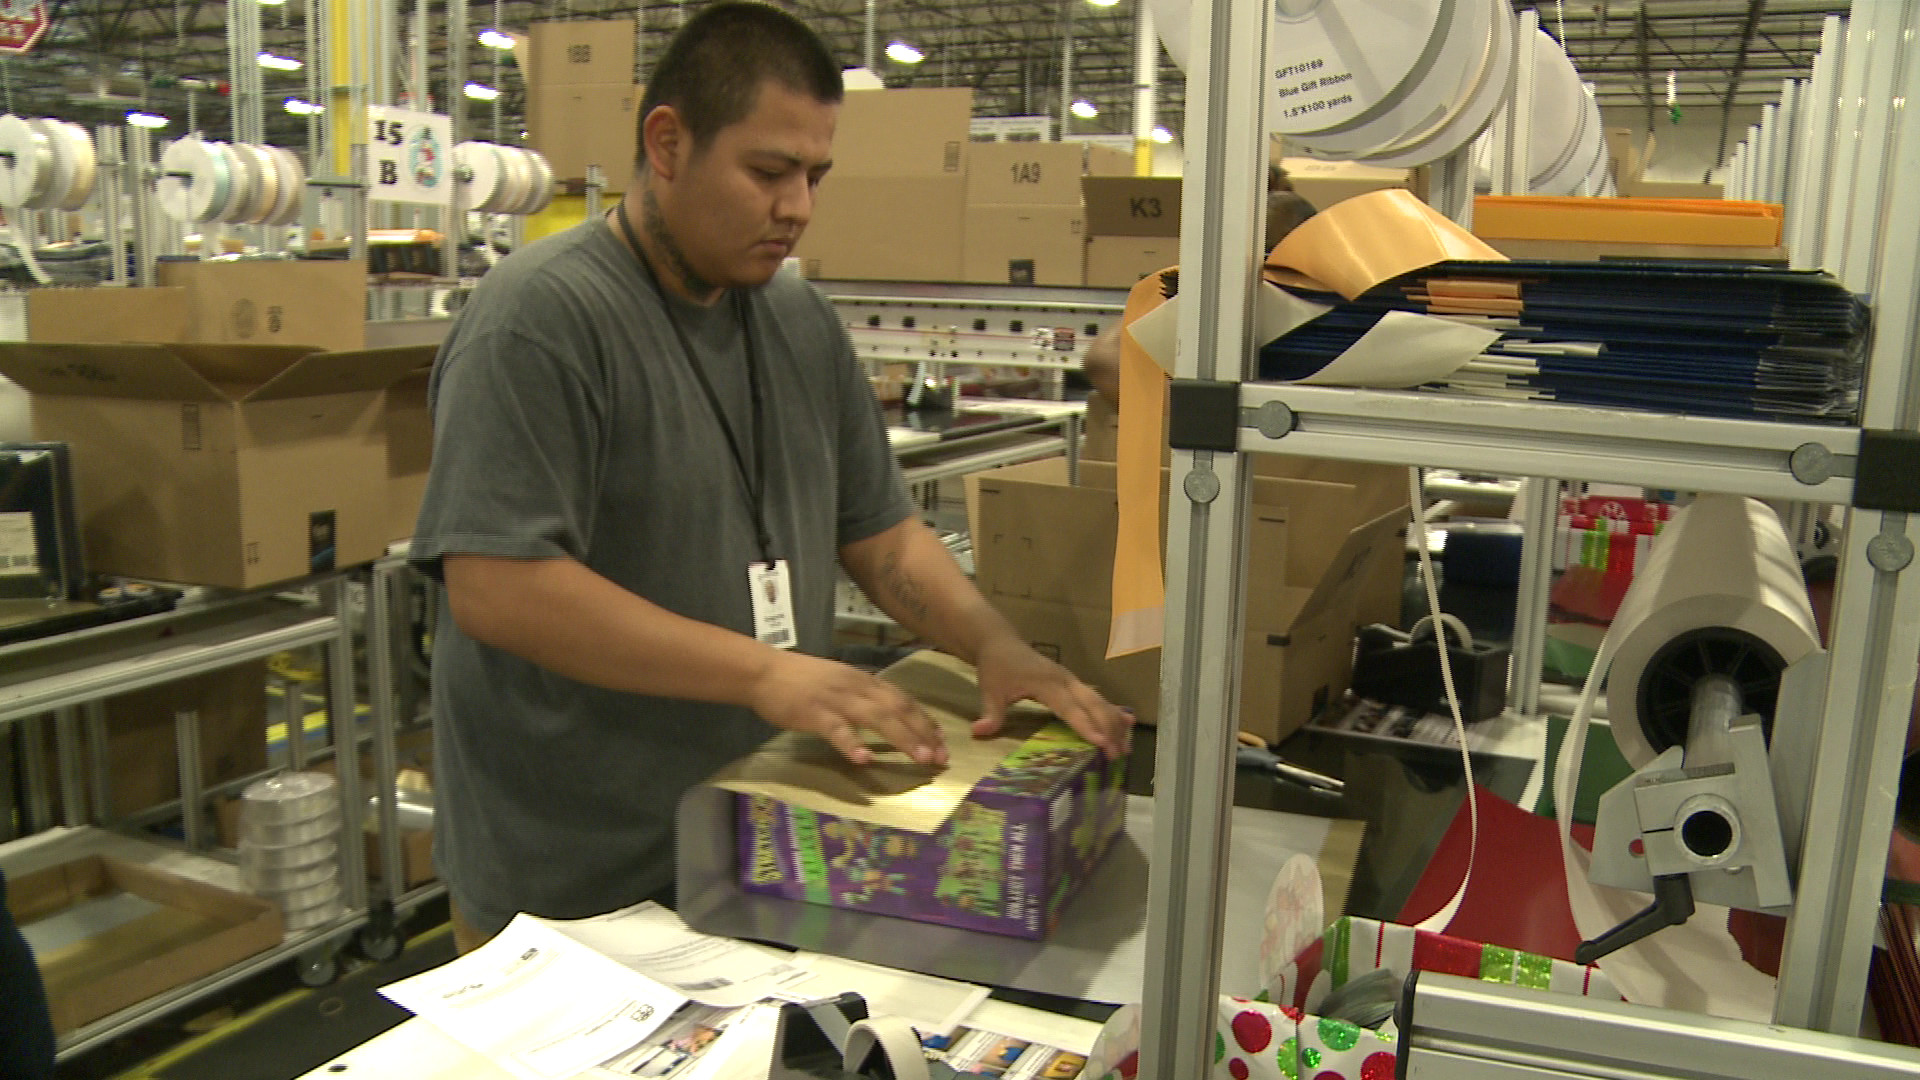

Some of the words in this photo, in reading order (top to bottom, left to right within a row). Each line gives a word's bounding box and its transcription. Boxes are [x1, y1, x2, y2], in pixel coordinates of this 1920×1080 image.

[1275, 58, 1323, 79] GFT10169
[1279, 86, 1299, 98] Blue
[1301, 80, 1318, 92] Gift
[1319, 72, 1352, 87] Ribbon
[1326, 94, 1352, 110] yards
[378, 160, 399, 185] B
[1010, 162, 1041, 184] 1A9
[1130, 197, 1163, 218] K3
[1009, 823, 1030, 842] ALL
[1007, 845, 1027, 871] THEM
[1006, 874, 1026, 920] COLLECT
